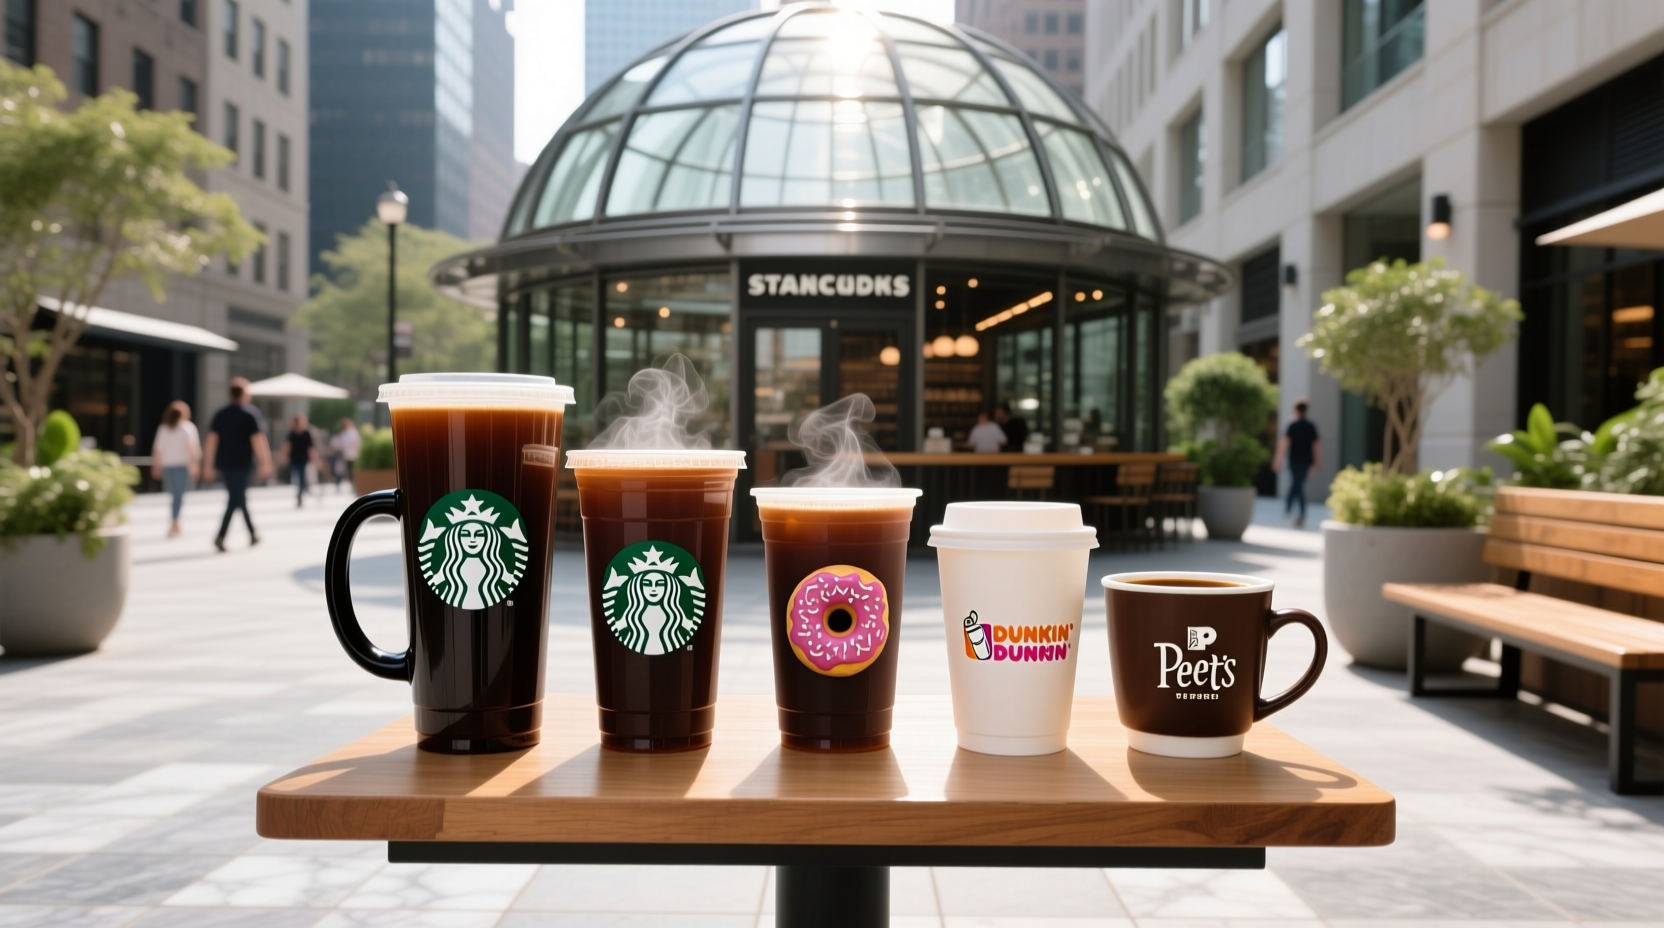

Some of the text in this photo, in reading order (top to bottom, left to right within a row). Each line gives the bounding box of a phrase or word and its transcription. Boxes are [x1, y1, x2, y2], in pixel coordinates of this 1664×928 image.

[748, 273, 910, 297] STANCUDKS
[993, 623, 1074, 644] DUNKIN'
[1153, 642, 1236, 691] Peet's
